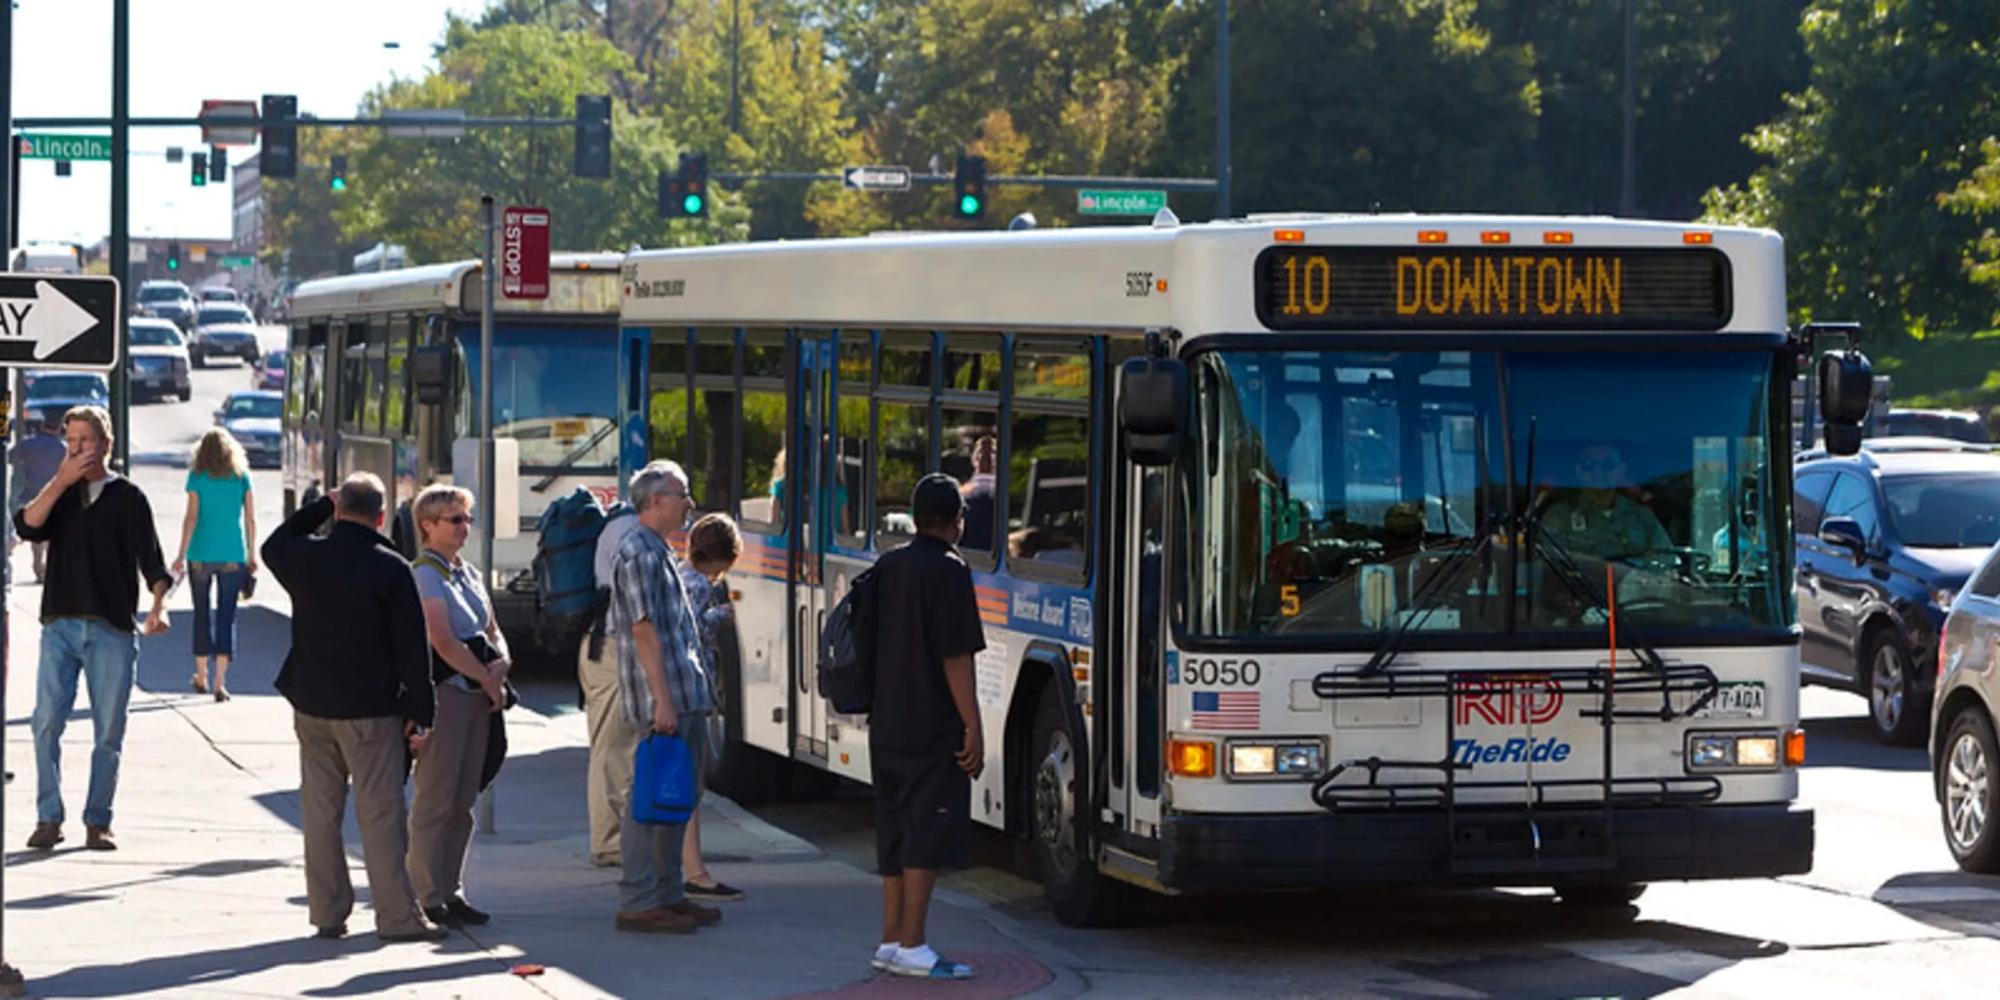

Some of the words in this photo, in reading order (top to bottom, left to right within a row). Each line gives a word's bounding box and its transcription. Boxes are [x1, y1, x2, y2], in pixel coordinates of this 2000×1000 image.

[35, 137, 102, 156] Lincoln
[505, 226, 521, 275] STOP
[1283, 256, 1331, 315] 10
[1396, 256, 1622, 316] DOWNTOWN
[1280, 584, 1300, 617] 5
[1184, 658, 1261, 686] 5050
[1456, 673, 1563, 725] RTD
[1450, 737, 1571, 765] TheRide
